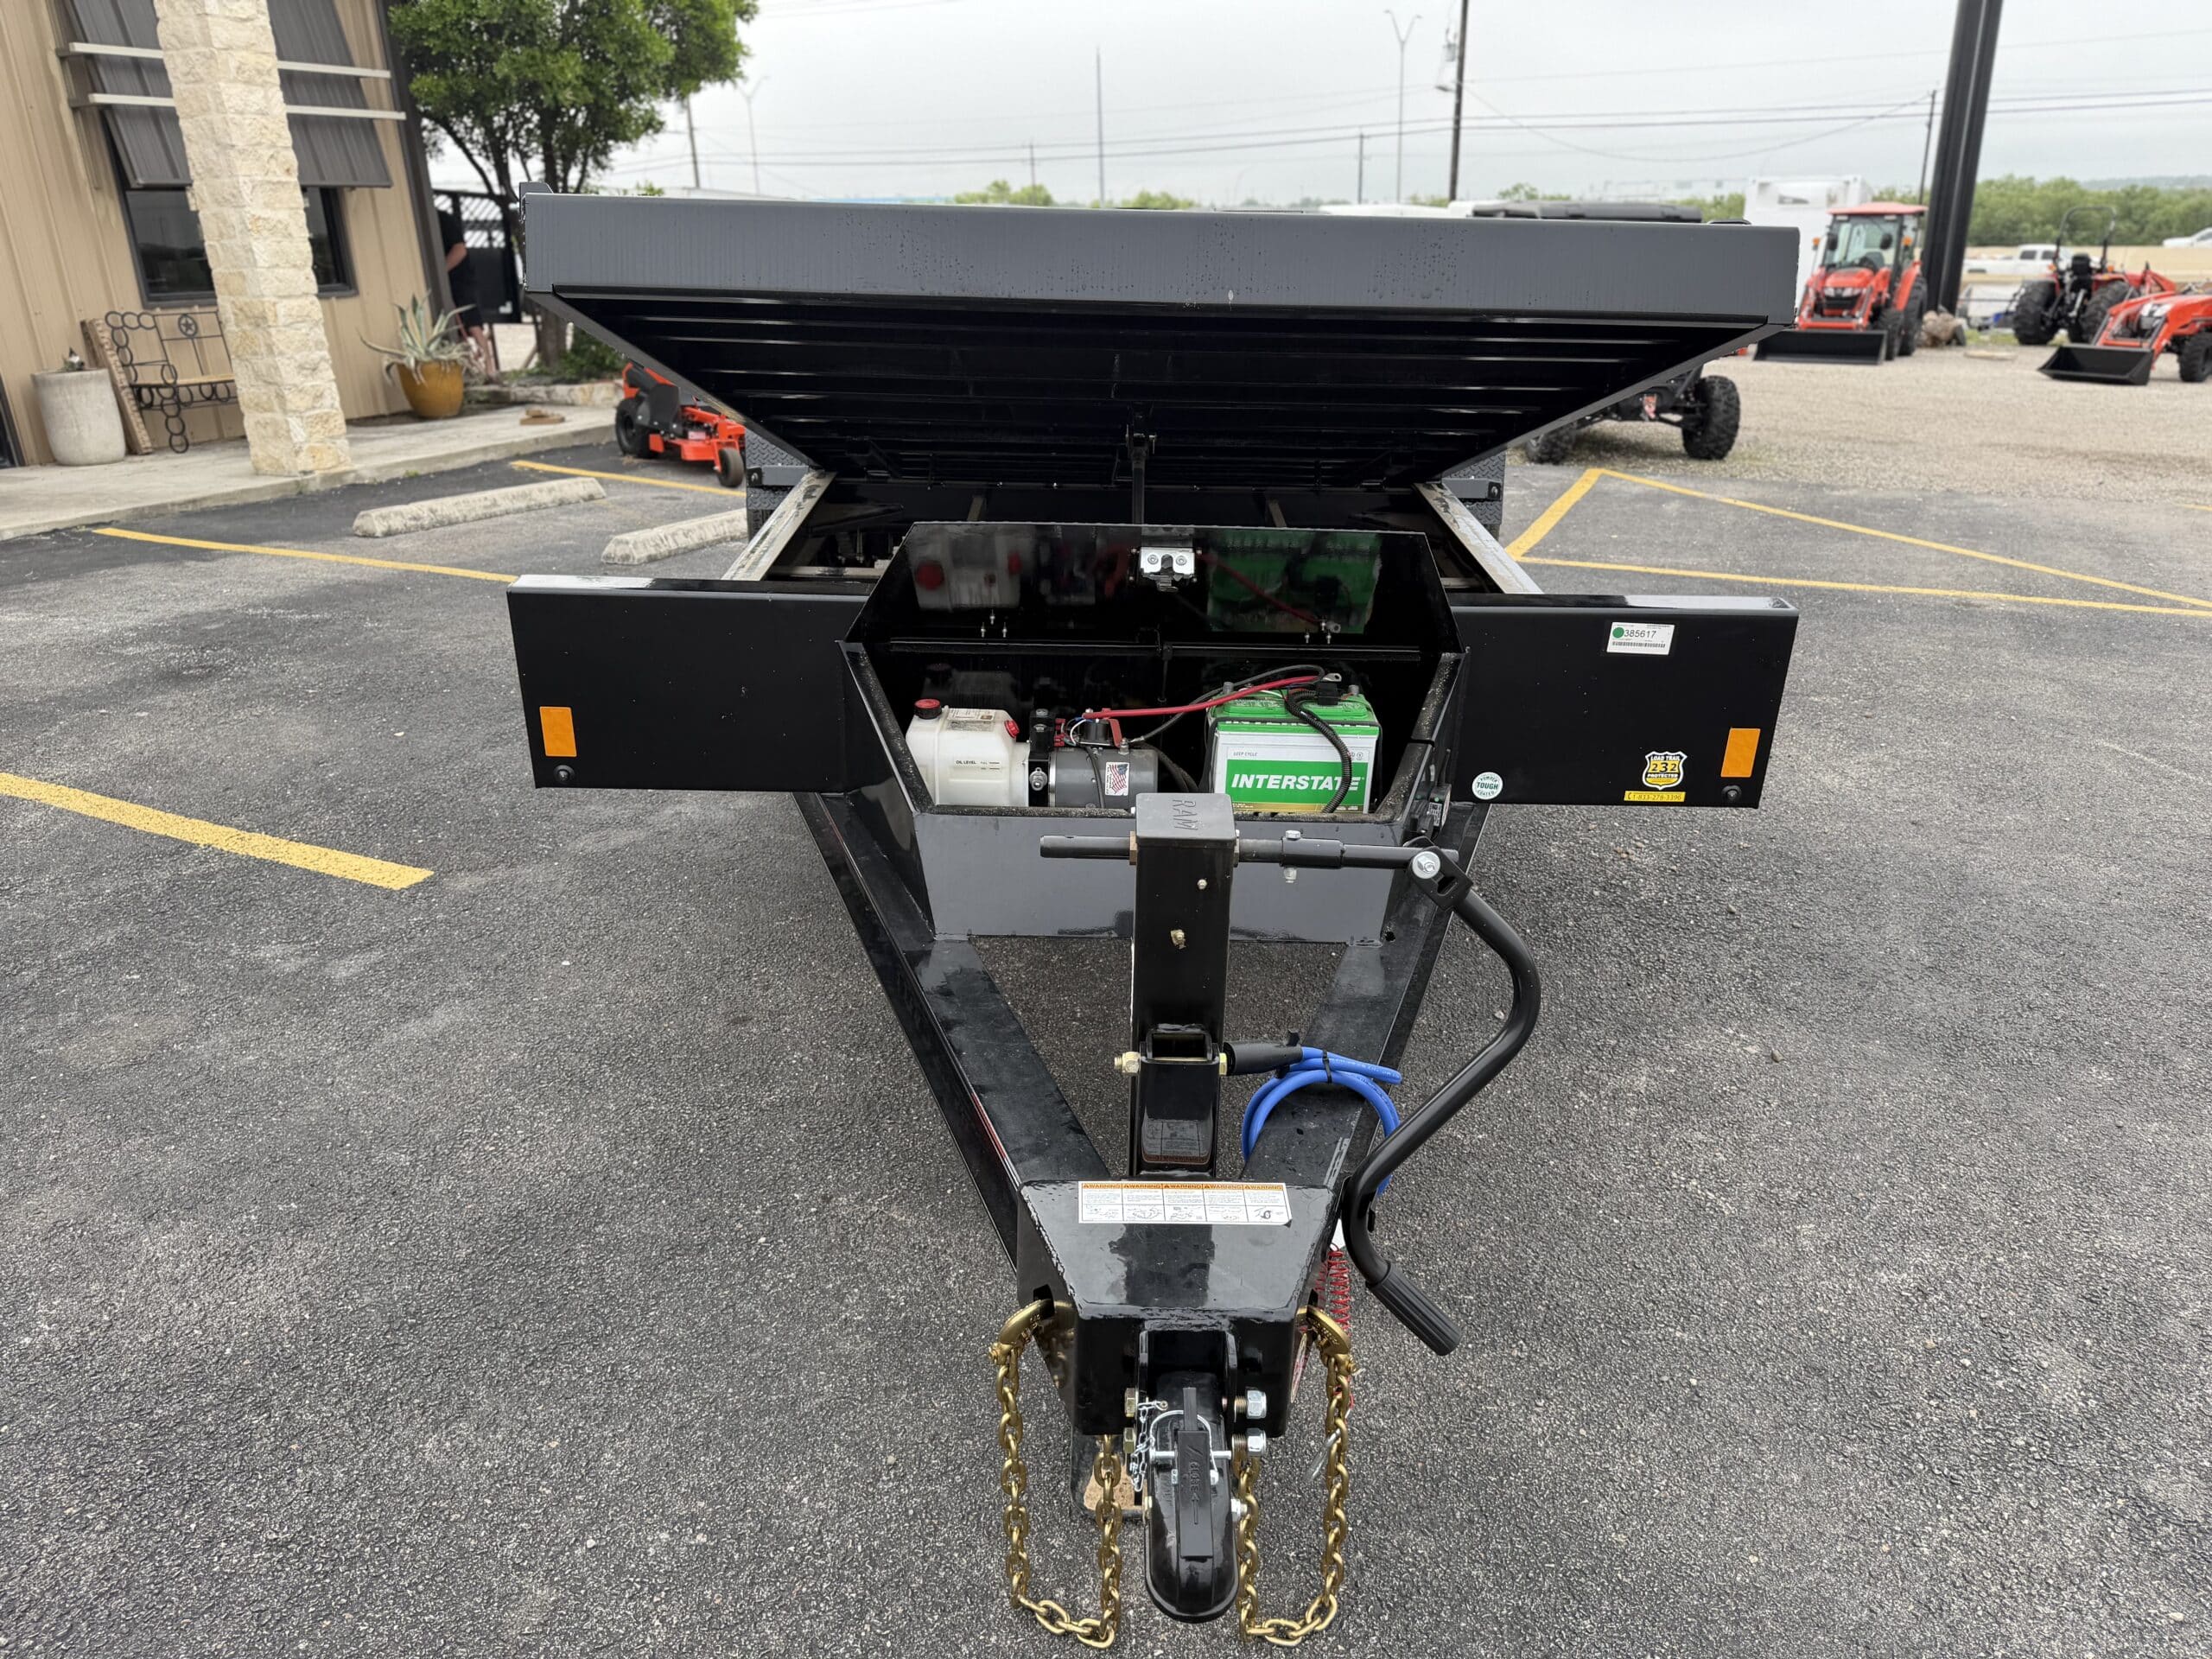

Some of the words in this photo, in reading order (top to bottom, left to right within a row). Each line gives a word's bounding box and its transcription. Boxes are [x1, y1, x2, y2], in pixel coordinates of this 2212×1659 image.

[1624, 629, 1656, 639] 385617
[1651, 762, 1677, 772] 232
[1231, 773, 1361, 791] INTERSTATE
[1172, 799, 1198, 830] RAM
